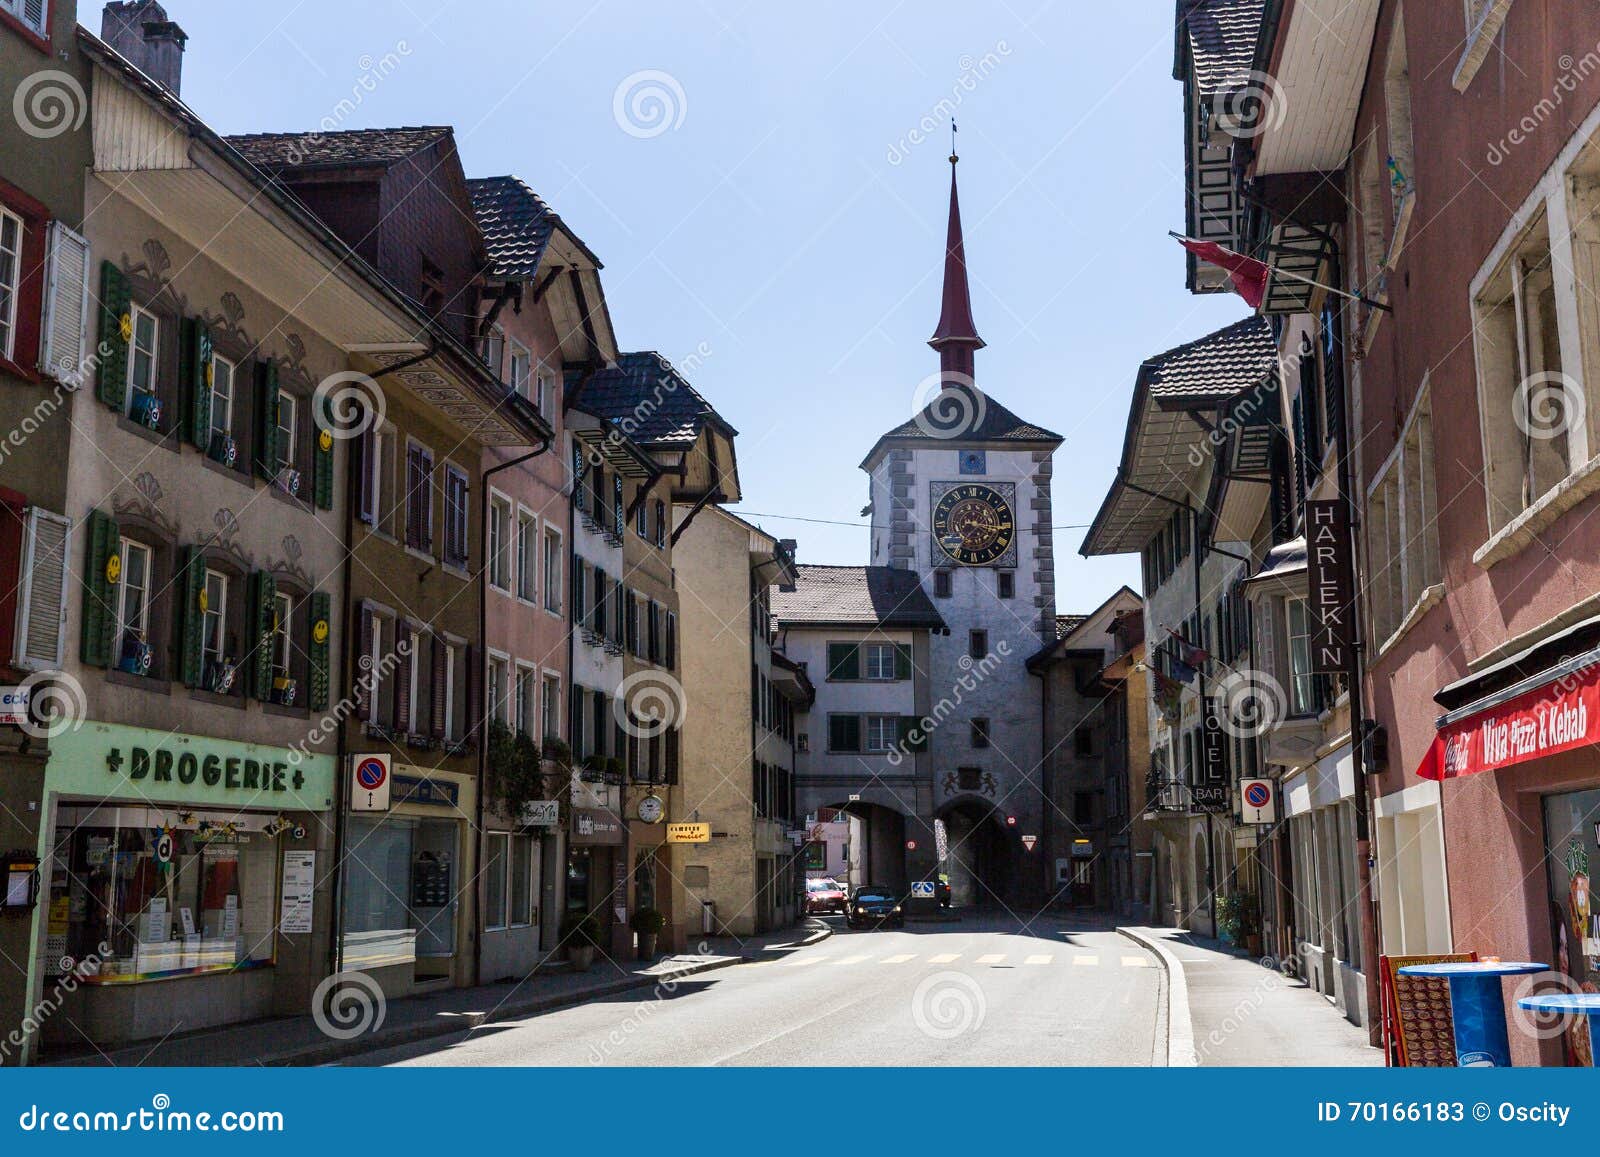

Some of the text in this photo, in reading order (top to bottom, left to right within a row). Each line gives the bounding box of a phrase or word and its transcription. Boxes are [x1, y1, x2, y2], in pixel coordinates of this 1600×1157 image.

[1314, 506, 1342, 666] HARLEKIN
[1205, 700, 1222, 779] HOTEL
[1483, 696, 1587, 765] Viva Pizza & Kebab
[130, 747, 288, 792] DROGERIE
[1196, 788, 1223, 800] BAR
